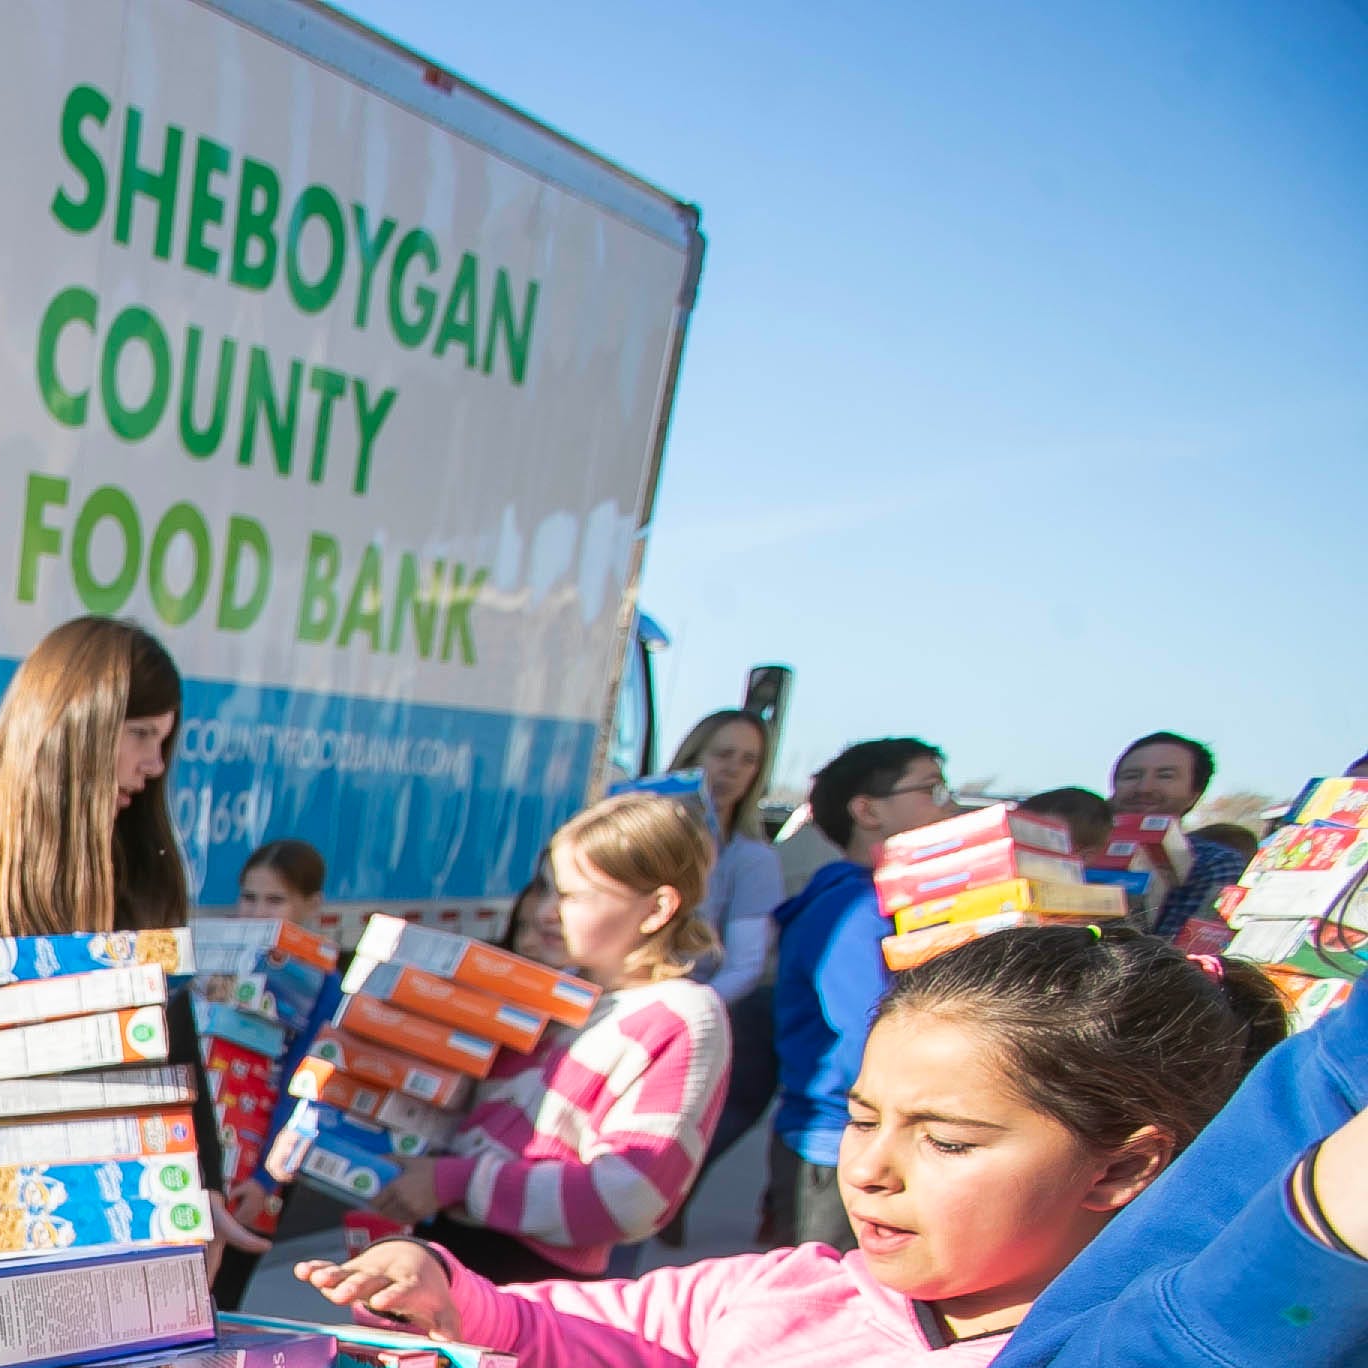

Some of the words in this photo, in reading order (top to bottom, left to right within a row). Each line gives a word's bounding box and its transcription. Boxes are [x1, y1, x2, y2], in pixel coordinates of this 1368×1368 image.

[50, 84, 541, 387] SHEBOYGAN
[36, 285, 400, 496] COUNTY
[17, 472, 272, 632] FOOD
[296, 531, 490, 667] BANK
